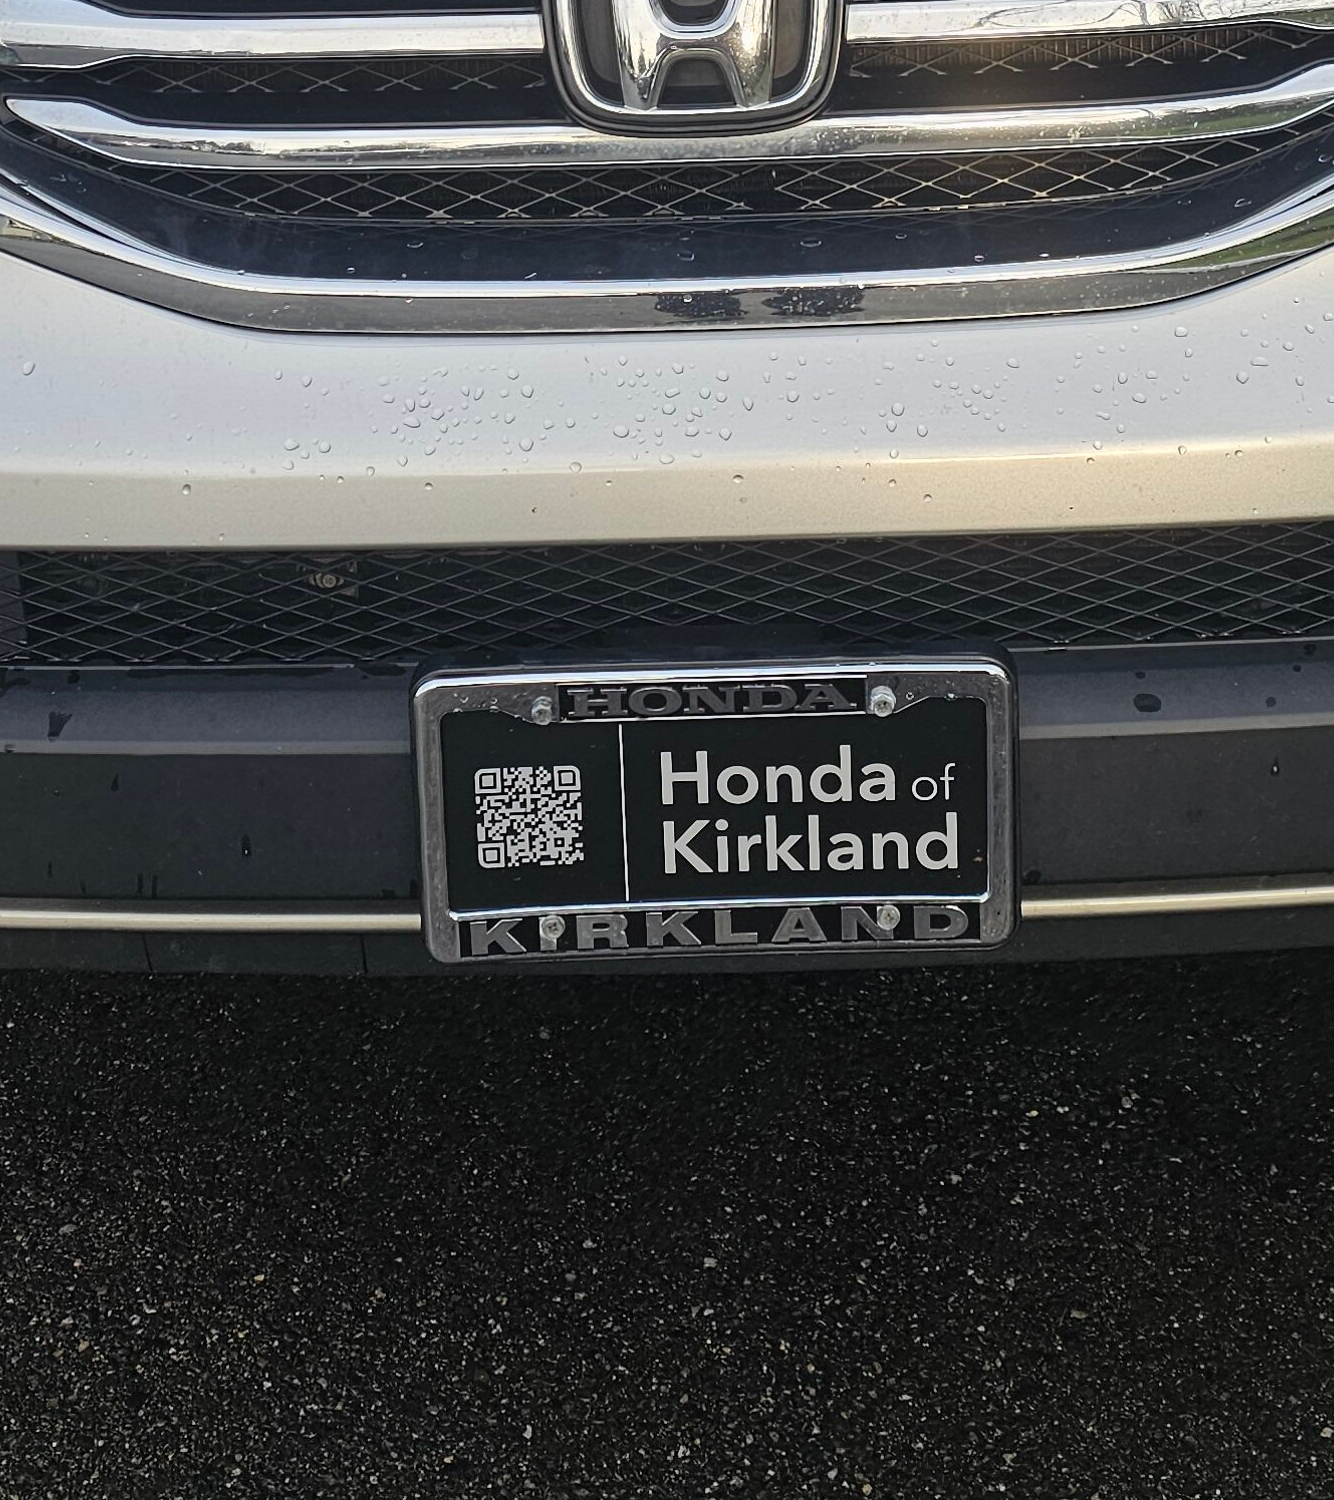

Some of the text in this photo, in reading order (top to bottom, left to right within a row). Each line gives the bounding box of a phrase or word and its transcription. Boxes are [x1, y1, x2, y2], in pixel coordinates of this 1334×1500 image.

[567, 683, 856, 718] HONDA
[660, 744, 957, 805] Honda of
[662, 811, 960, 875] Kirkland
[469, 904, 969, 956] KIRKLAND
